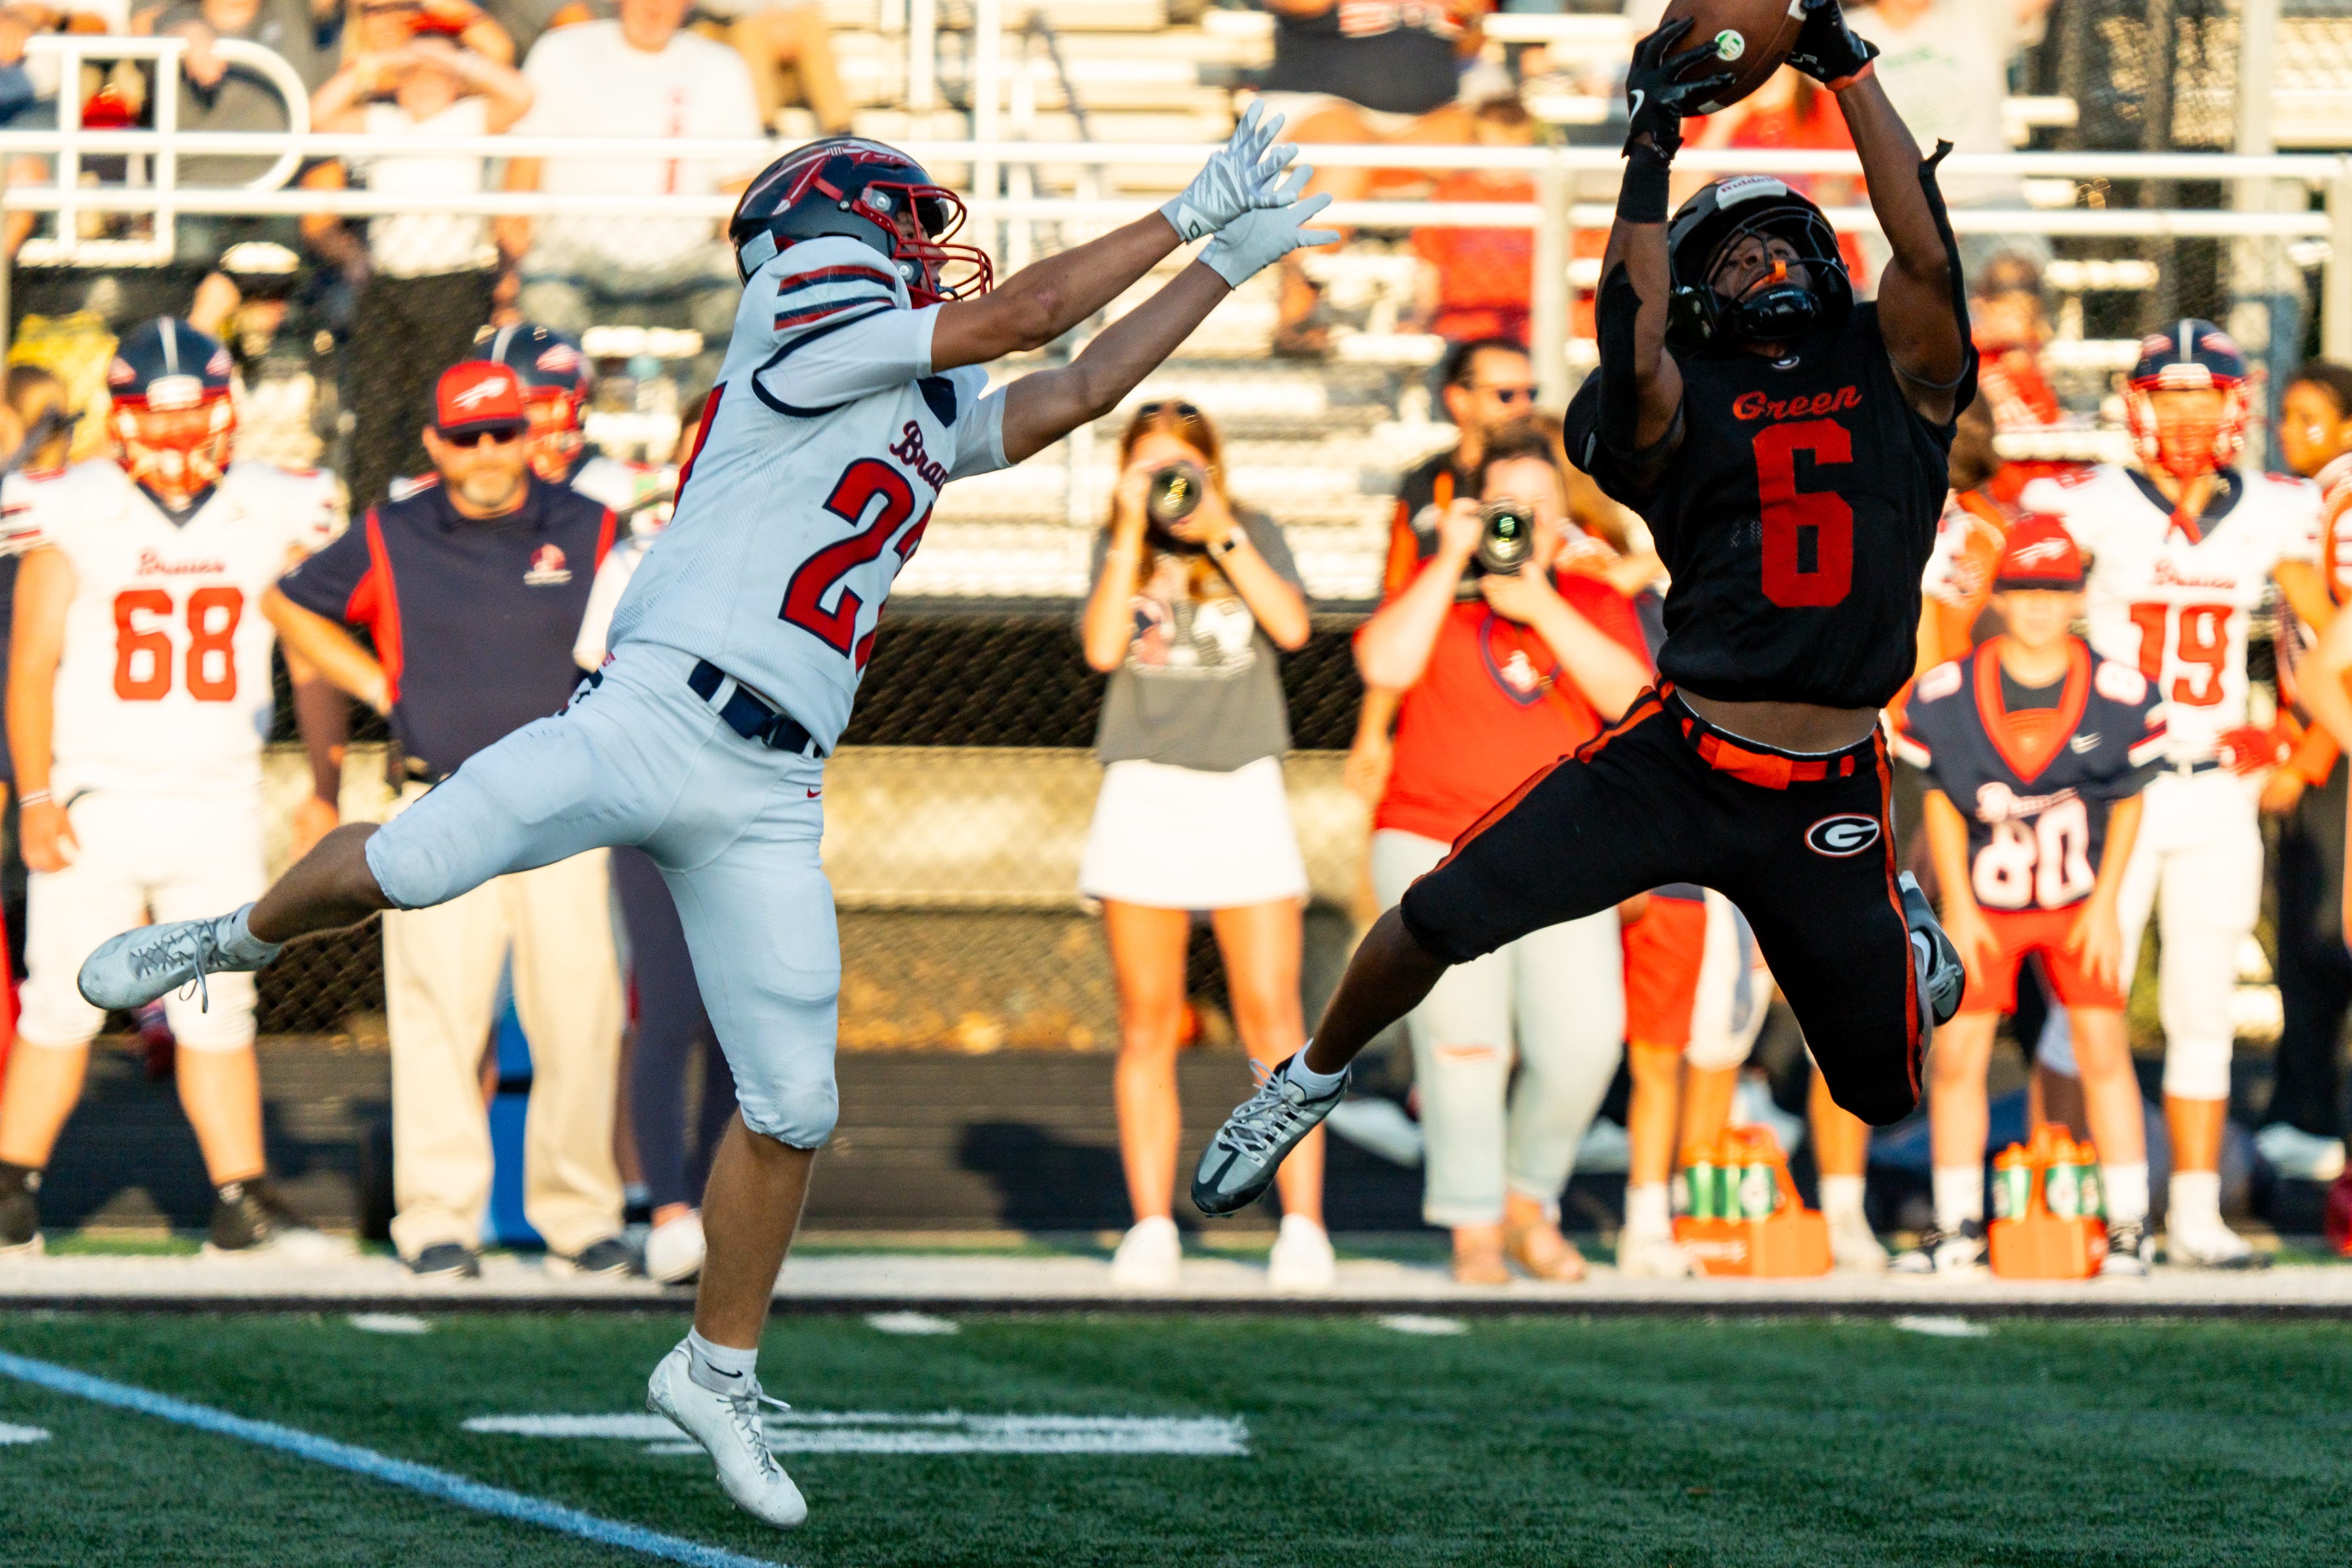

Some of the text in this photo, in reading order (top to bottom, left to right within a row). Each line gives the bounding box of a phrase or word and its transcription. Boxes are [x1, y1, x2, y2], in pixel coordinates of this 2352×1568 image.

[1733, 385, 1862, 420] Green
[1752, 418, 1854, 608] 6
[114, 588, 244, 701] 68
[2131, 602, 2234, 706] 19
[1808, 815, 1880, 855] G
[1972, 797, 2096, 911] 80
